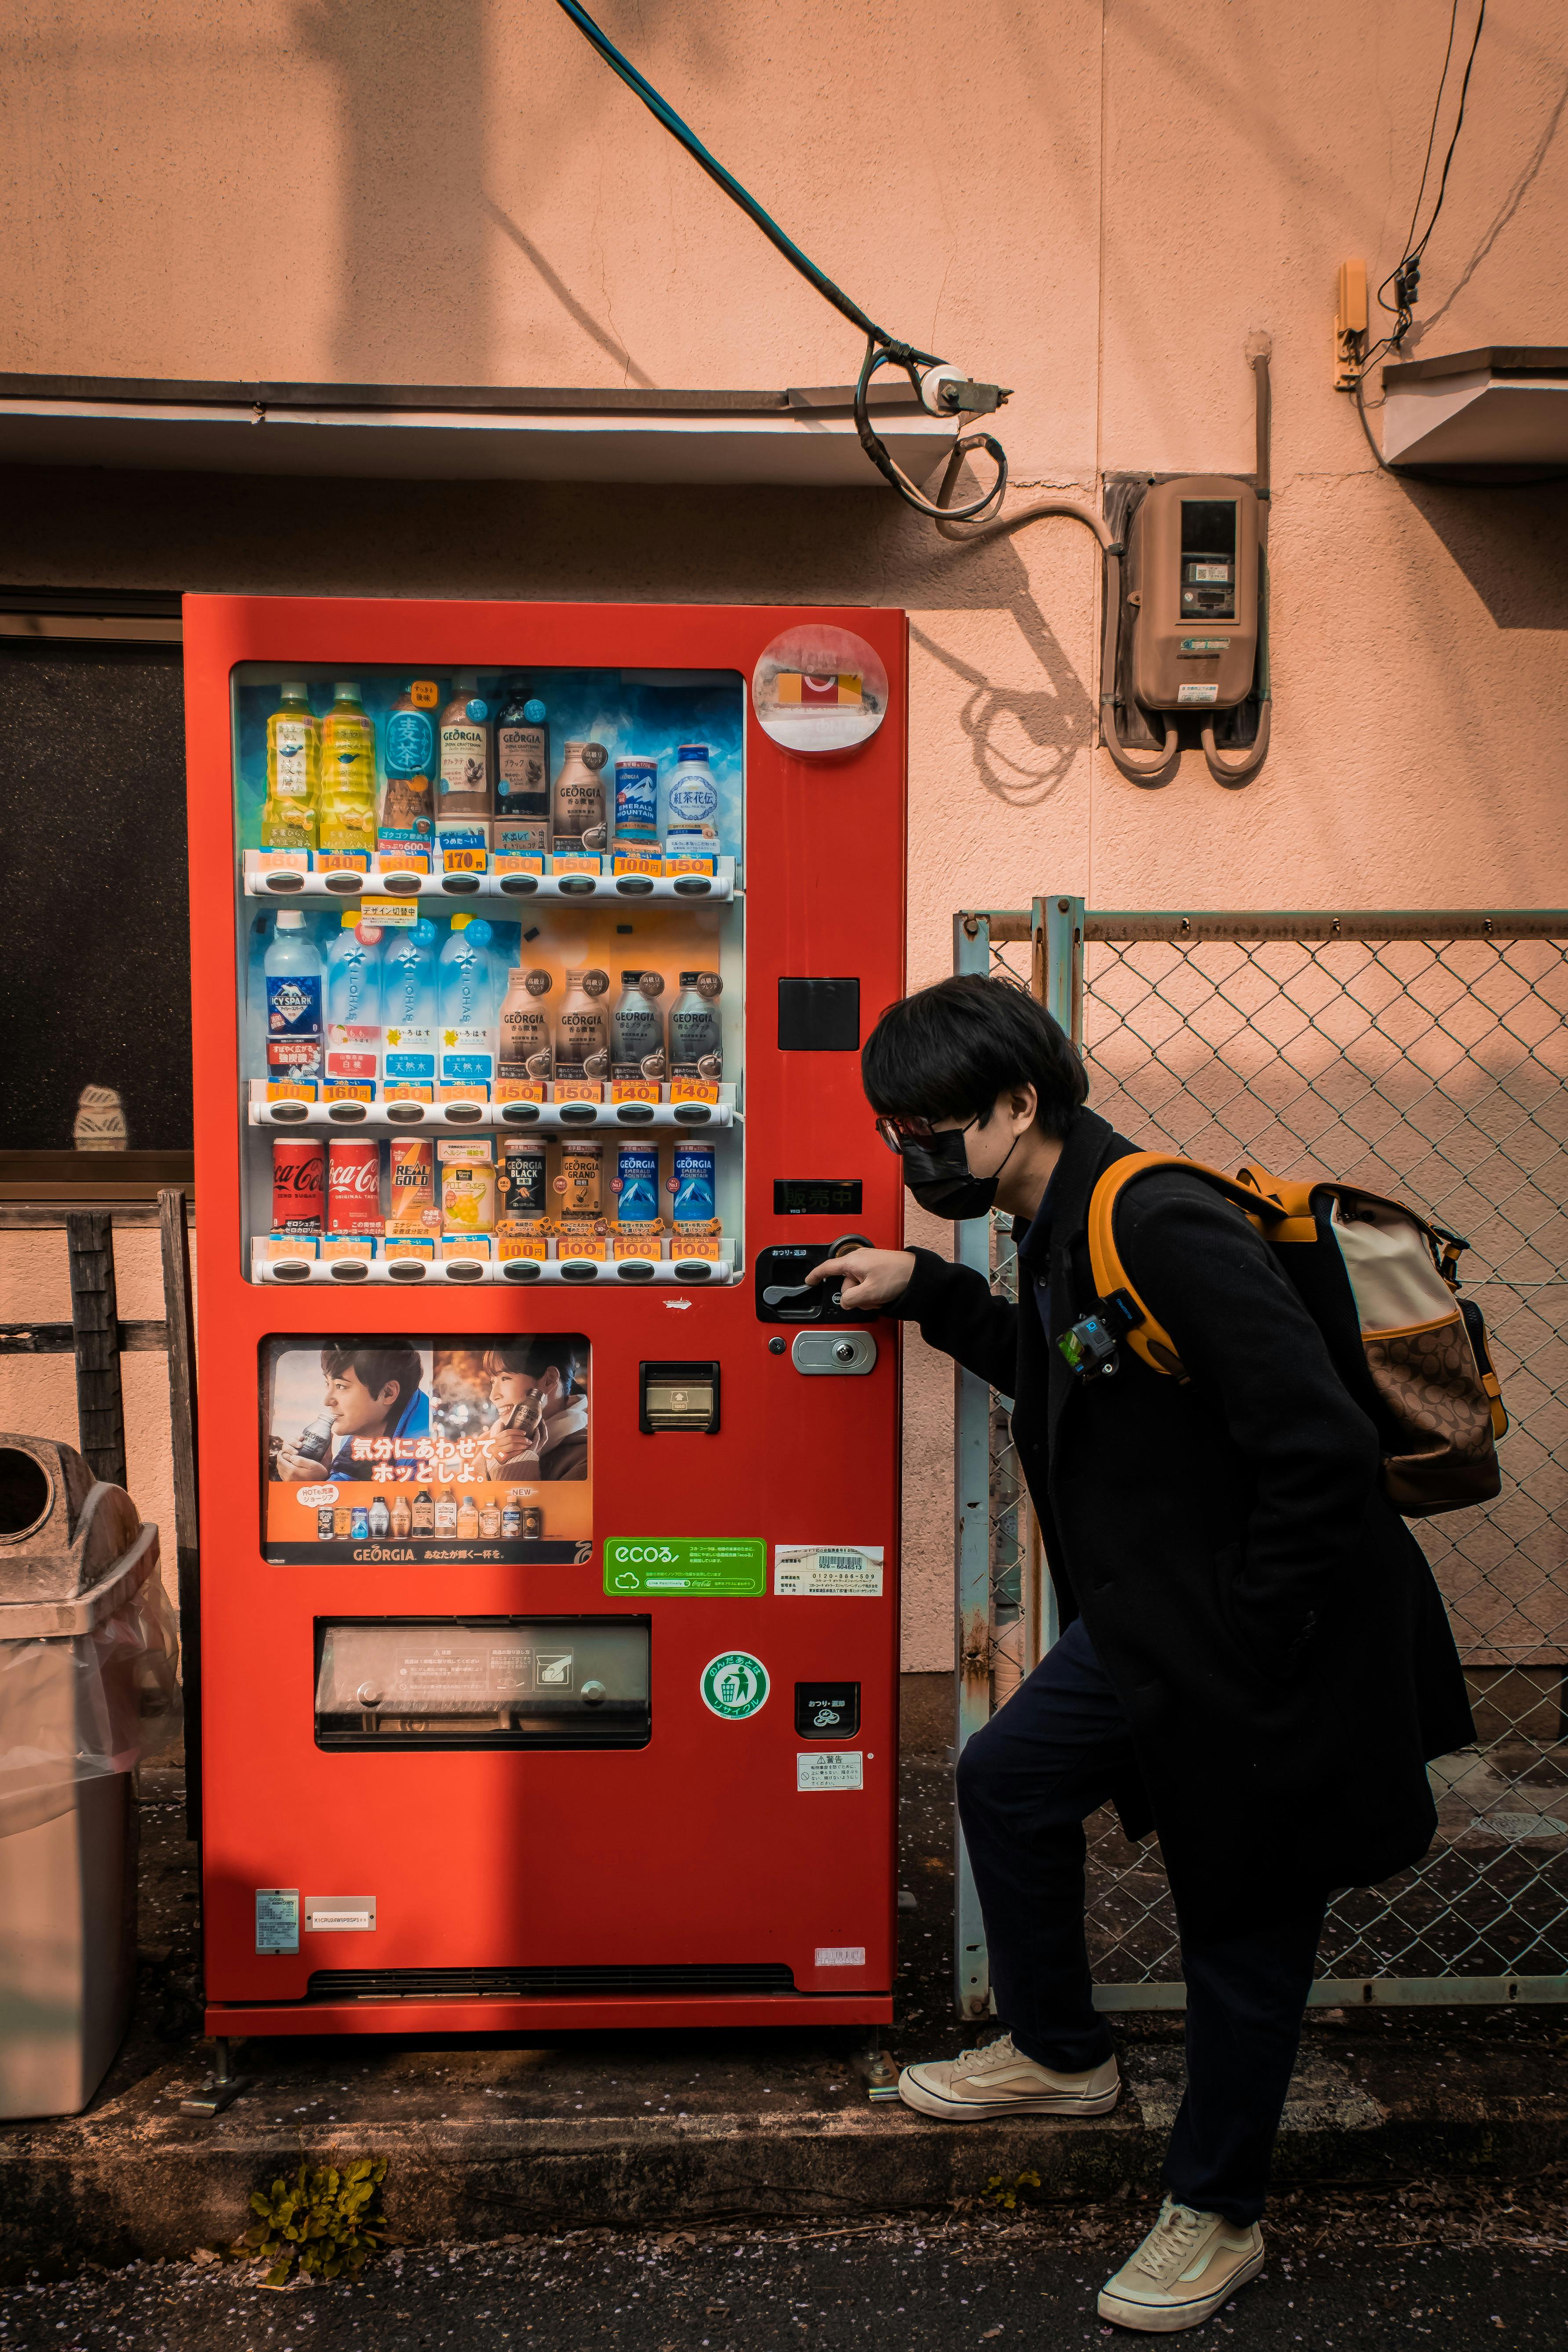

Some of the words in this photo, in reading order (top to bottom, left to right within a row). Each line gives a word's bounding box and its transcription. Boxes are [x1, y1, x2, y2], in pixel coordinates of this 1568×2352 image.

[396, 717, 420, 766] 麦茶
[443, 728, 483, 742] GEORGIA
[503, 731, 541, 743] GEORGIA
[560, 784, 601, 797] GEORGIA
[673, 792, 714, 805] 紅茶花伝
[617, 809, 654, 818] MOUNTAIN
[618, 803, 652, 812] EMERALD
[382, 831, 429, 841] ゴクゴク飲める
[447, 852, 483, 869] 170円
[617, 859, 658, 873] 100円
[668, 859, 711, 872] 150円
[363, 907, 415, 916] デザイン切替中
[504, 1011, 546, 1024] GEORGIA
[561, 1012, 602, 1025] GEORGIA
[615, 1009, 655, 1021] GEORGIA
[673, 1011, 713, 1023] GEORGIA
[273, 1045, 313, 1053] すばやく広がる
[395, 1062, 426, 1072] 天然水
[451, 1063, 484, 1074] 天然水
[498, 1086, 540, 1100] 150円
[557, 1087, 598, 1100] 150円
[615, 1087, 656, 1100] 140円
[674, 1084, 715, 1100] 140円
[397, 1161, 430, 1176] REAL
[507, 1158, 542, 1170] GEORGIA
[564, 1160, 600, 1171] GEORGIA
[620, 1157, 655, 1169] GEORGIA
[676, 1157, 712, 1169] GEORGIA
[395, 1175, 429, 1187] GOLD
[784, 1188, 851, 1207] 販売中
[501, 1245, 542, 1256] 100円
[561, 1243, 603, 1255] 100円
[616, 1243, 658, 1256] 100円
[674, 1243, 716, 1256] 100円
[353, 1438, 506, 1460] 気分にあわせて、
[372, 1462, 485, 1484] ホッとしよ。
[303, 1494, 334, 1503] ジョージア
[353, 1544, 416, 1562] GEORGIA
[424, 1550, 505, 1559] あなたが輝く一杯を。
[709, 1656, 761, 1676] のんだあとは
[713, 1698, 759, 1715] リサイクル
